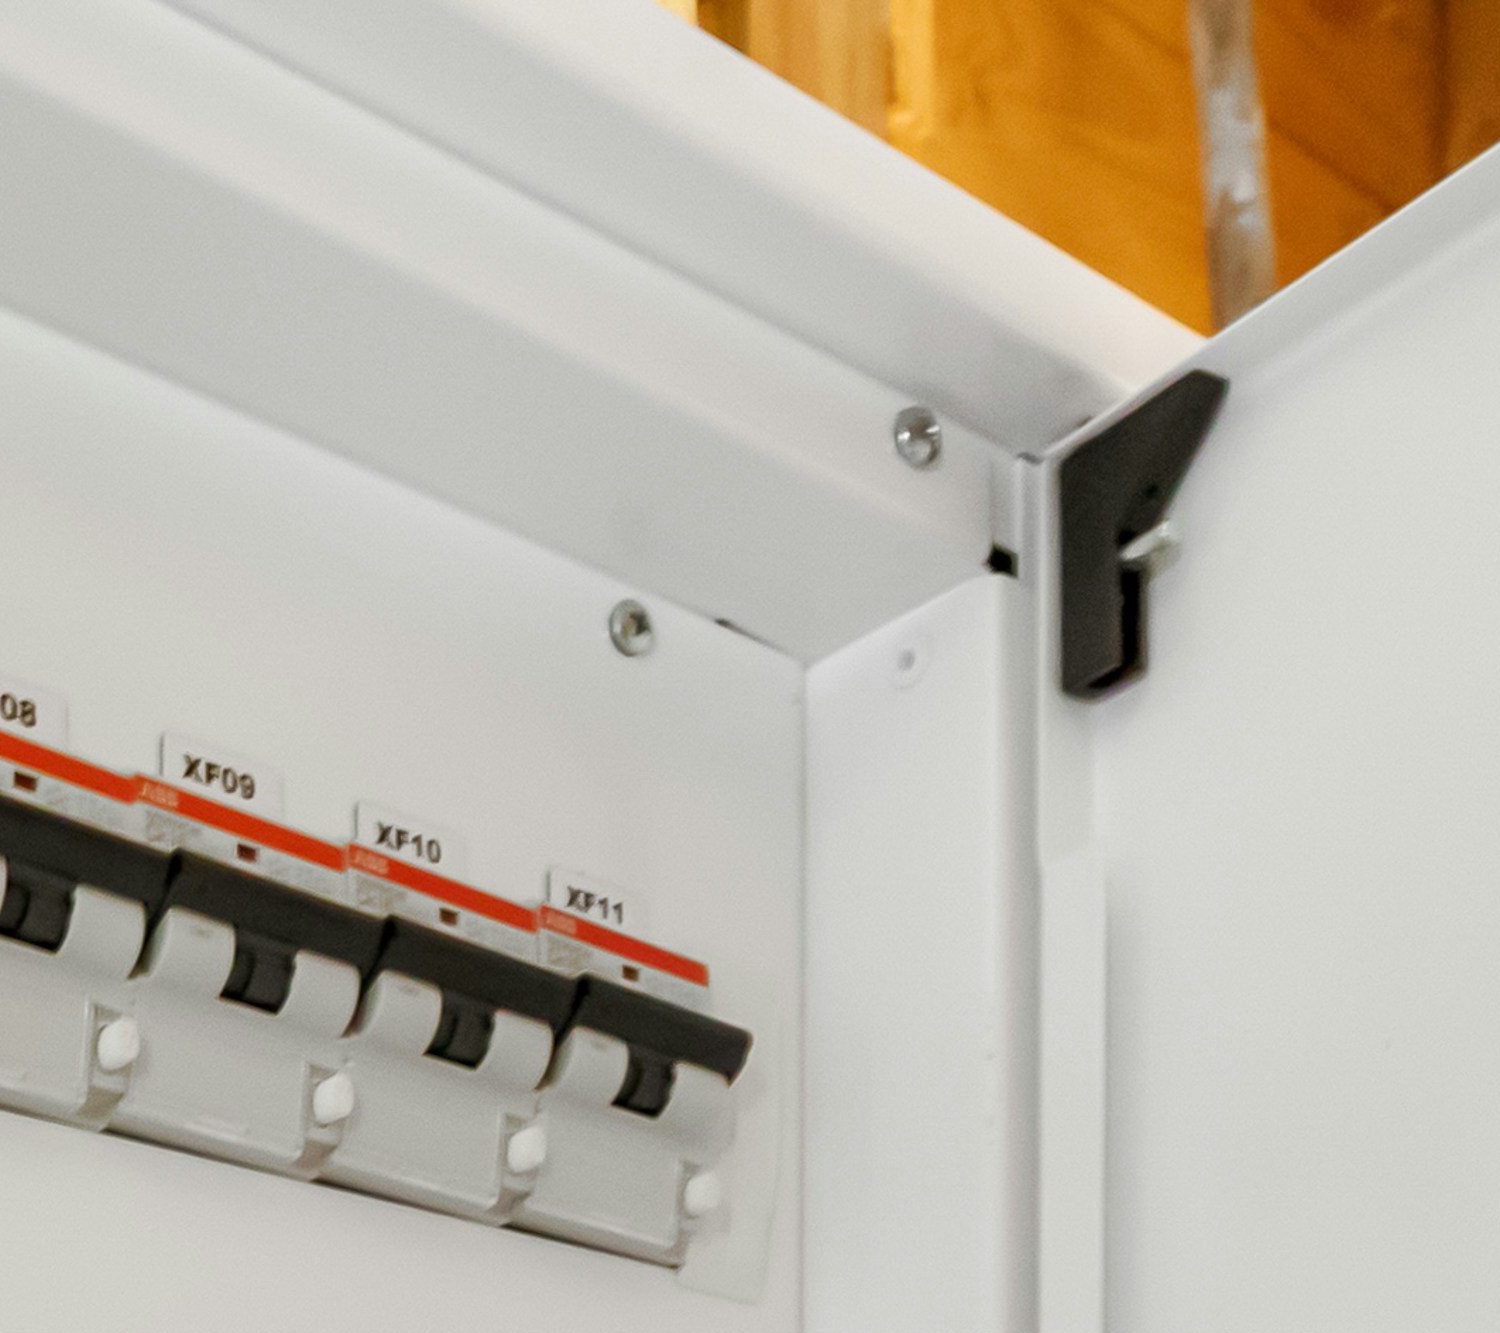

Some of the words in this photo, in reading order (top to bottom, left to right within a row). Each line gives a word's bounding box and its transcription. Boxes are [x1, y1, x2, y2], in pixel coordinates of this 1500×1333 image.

[179, 754, 256, 803] XF09
[372, 822, 442, 867] XF10
[563, 886, 623, 927] XF11
